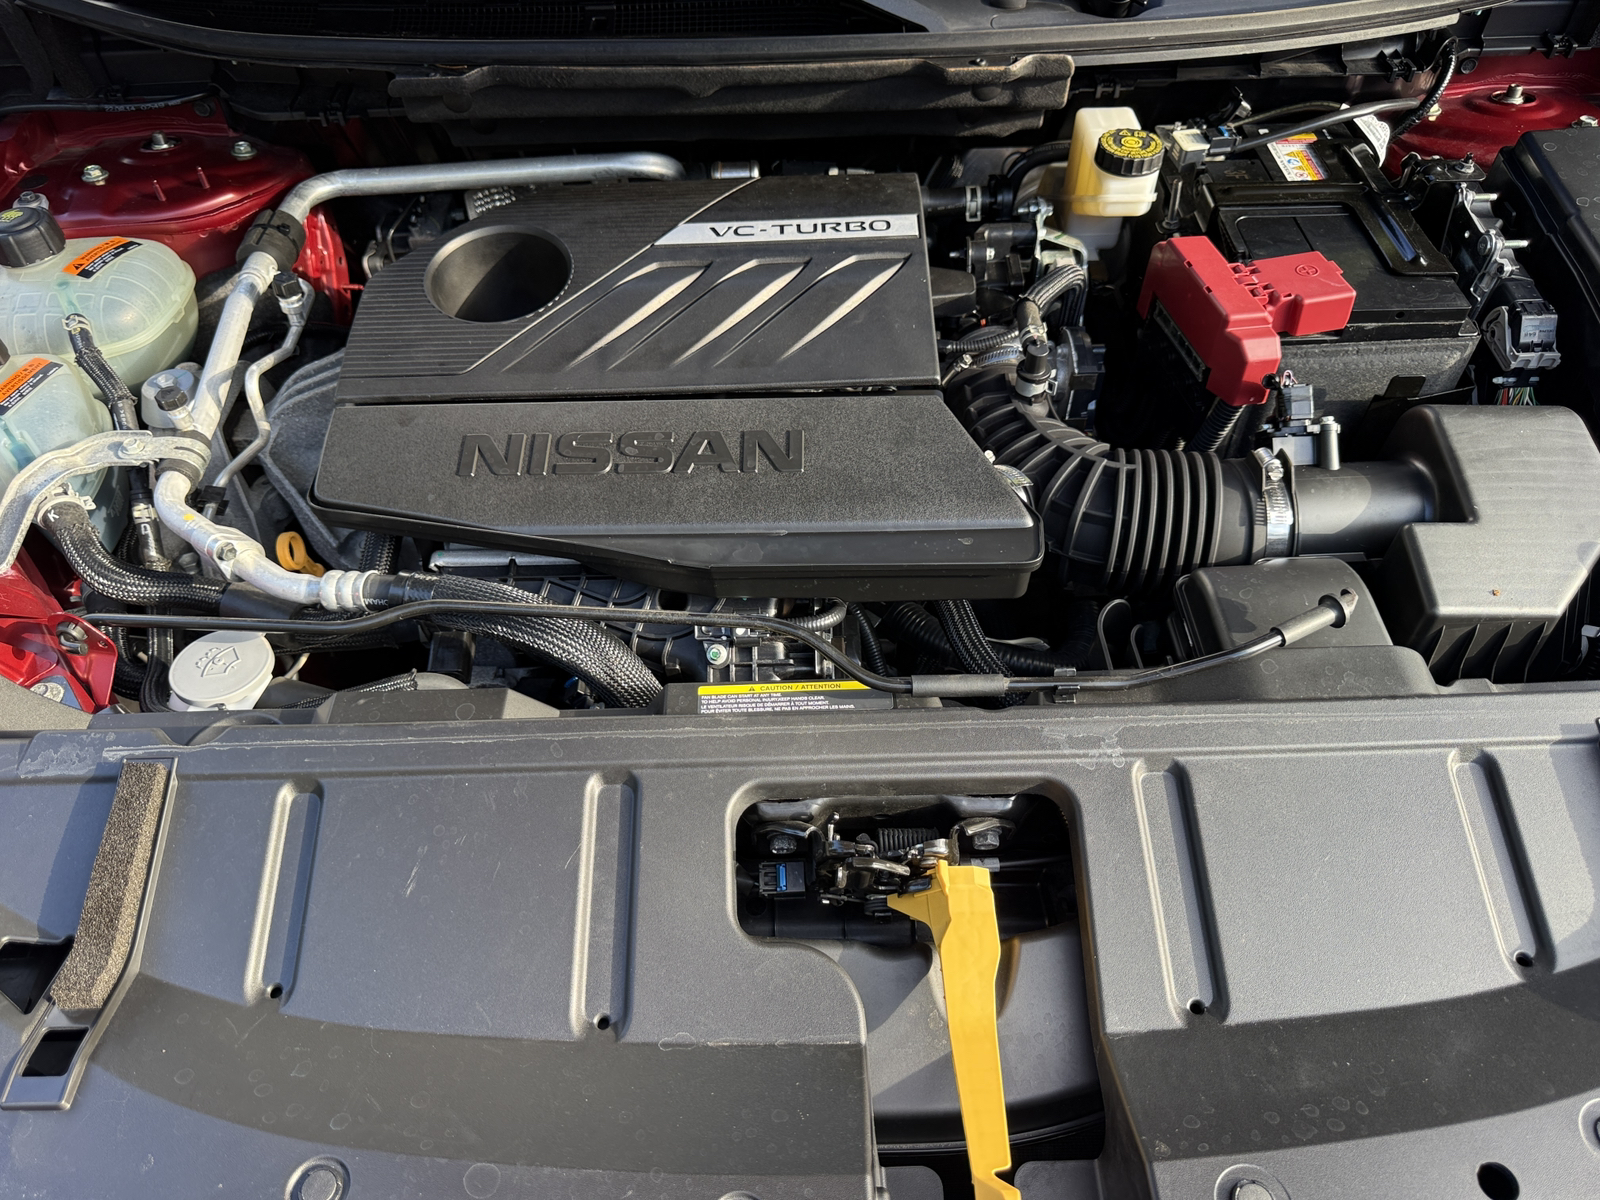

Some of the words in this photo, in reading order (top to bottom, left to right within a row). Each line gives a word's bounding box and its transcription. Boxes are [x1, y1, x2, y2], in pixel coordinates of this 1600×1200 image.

[709, 220, 891, 238] VC-TURBO
[459, 430, 804, 476] NISSAN
[47, 509, 60, 522] K
